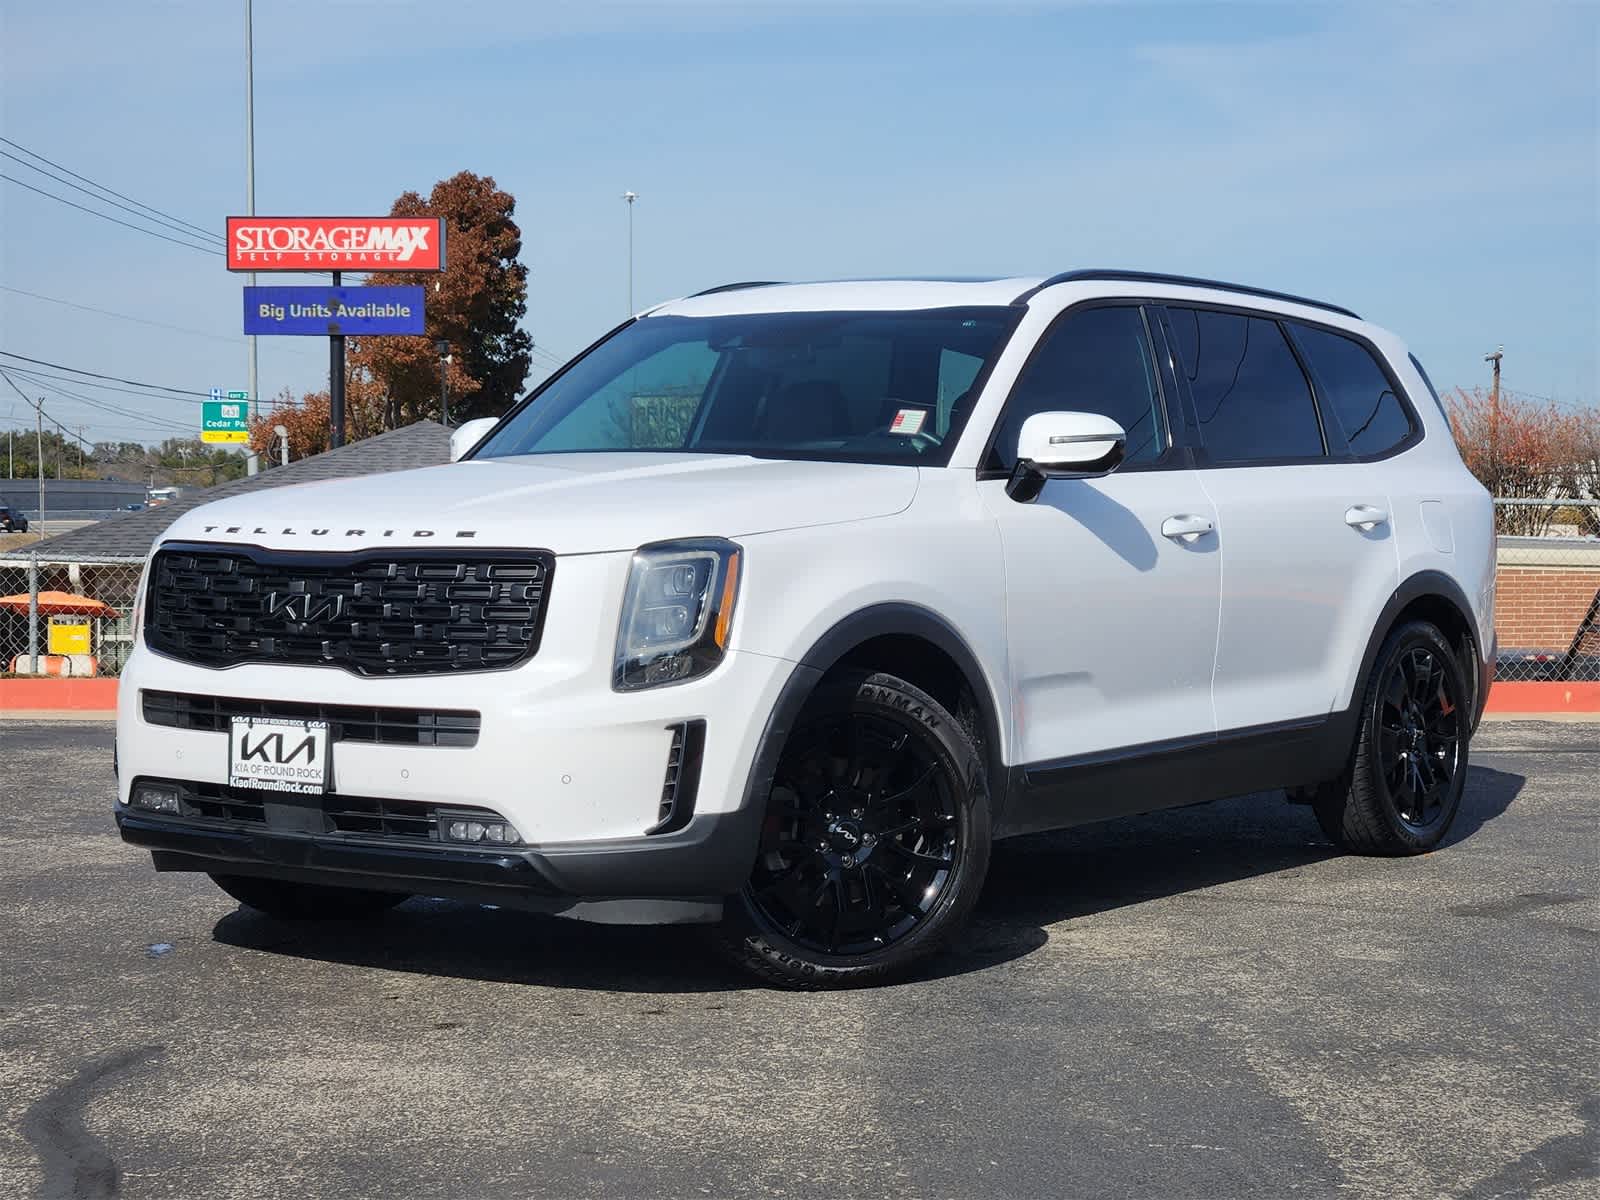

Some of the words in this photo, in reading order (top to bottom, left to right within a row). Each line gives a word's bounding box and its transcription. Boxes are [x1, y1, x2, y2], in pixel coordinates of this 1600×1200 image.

[236, 252, 283, 262] SELF
[303, 252, 396, 262] STORAGE
[259, 304, 285, 320] Big
[290, 303, 332, 318] Units
[336, 303, 411, 318] Available
[206, 420, 232, 428] Cedar
[234, 420, 249, 428] Pa
[204, 526, 478, 538] TELLURIDE
[264, 591, 343, 622] KIA
[241, 731, 315, 765] KIA
[235, 763, 249, 773] KIA
[251, 764, 262, 774] OF
[264, 765, 296, 777] ROUND
[297, 767, 322, 779] ROCK
